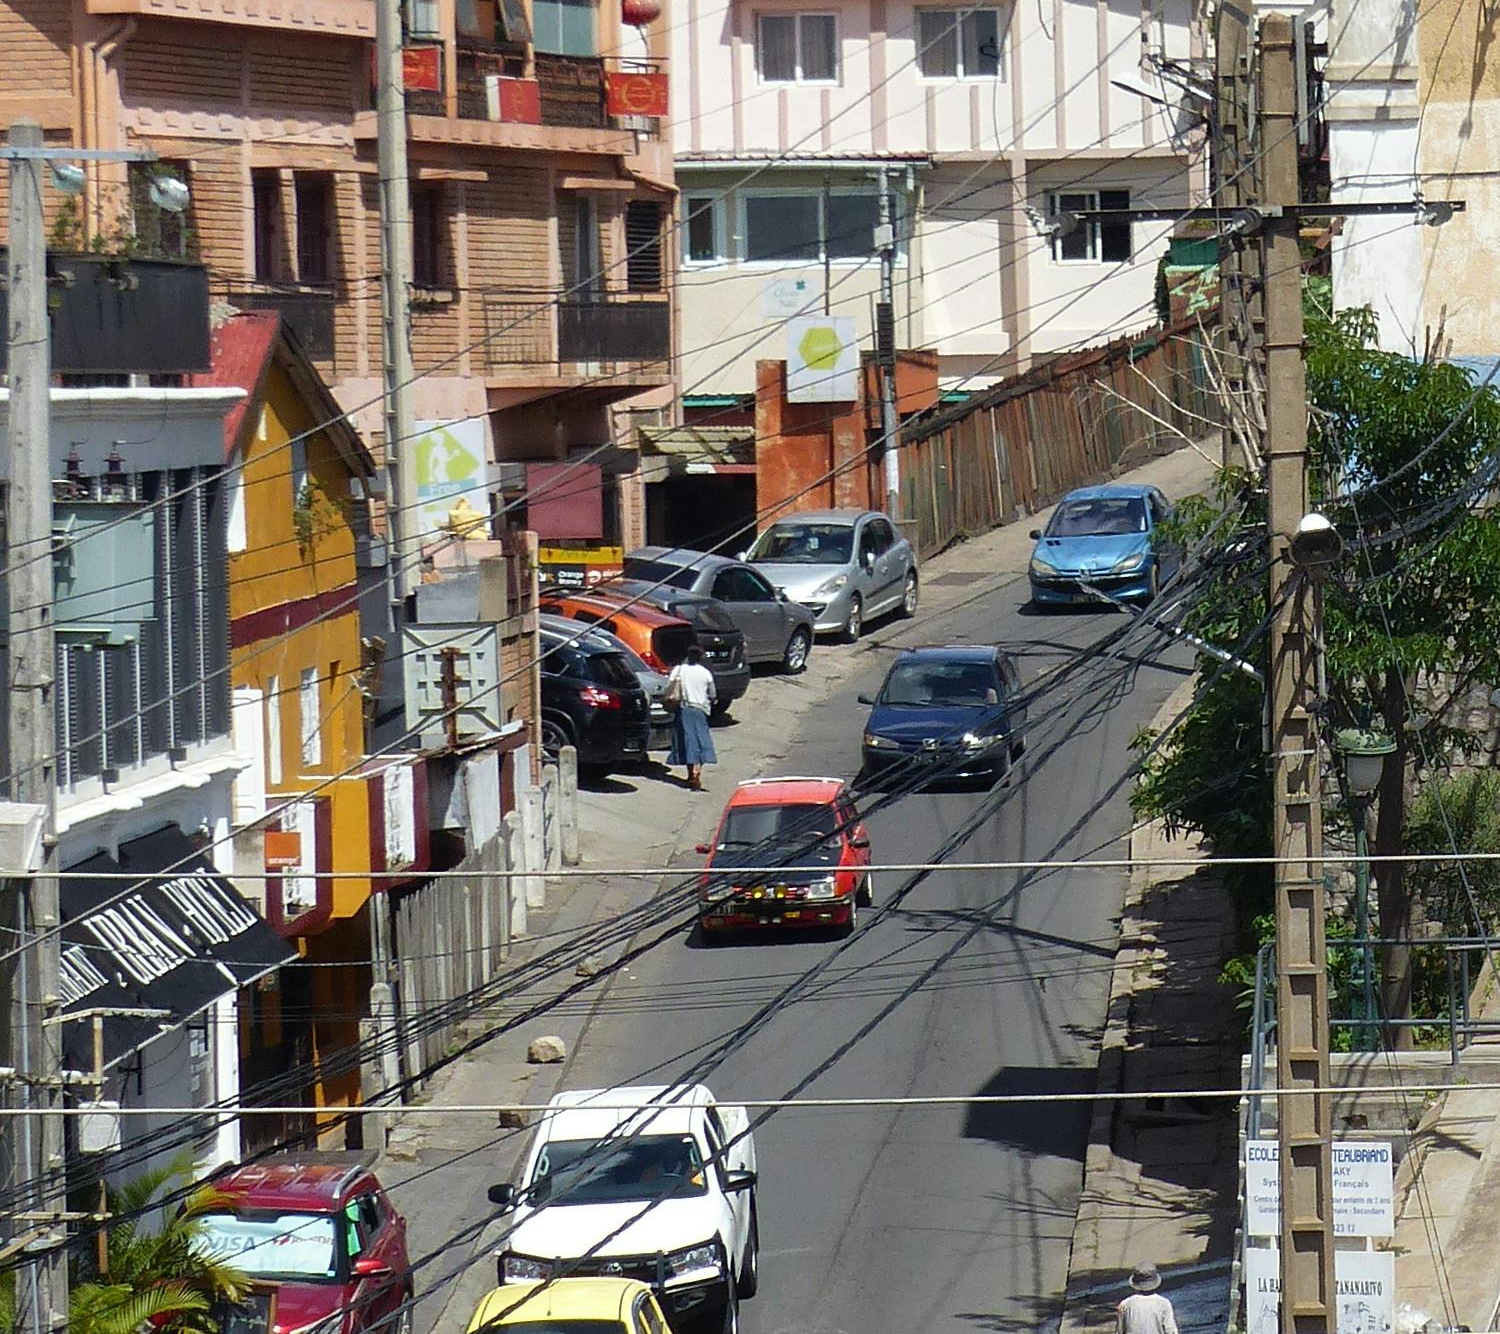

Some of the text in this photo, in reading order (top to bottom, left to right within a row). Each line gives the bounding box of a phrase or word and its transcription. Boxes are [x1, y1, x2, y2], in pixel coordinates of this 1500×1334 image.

[82, 894, 198, 985] URBAN
[1249, 1148, 1389, 1163] ECOLE TEAUBRIAND
[1334, 1179, 1369, 1188] Français
[1335, 1280, 1383, 1297] TANANARIVO
